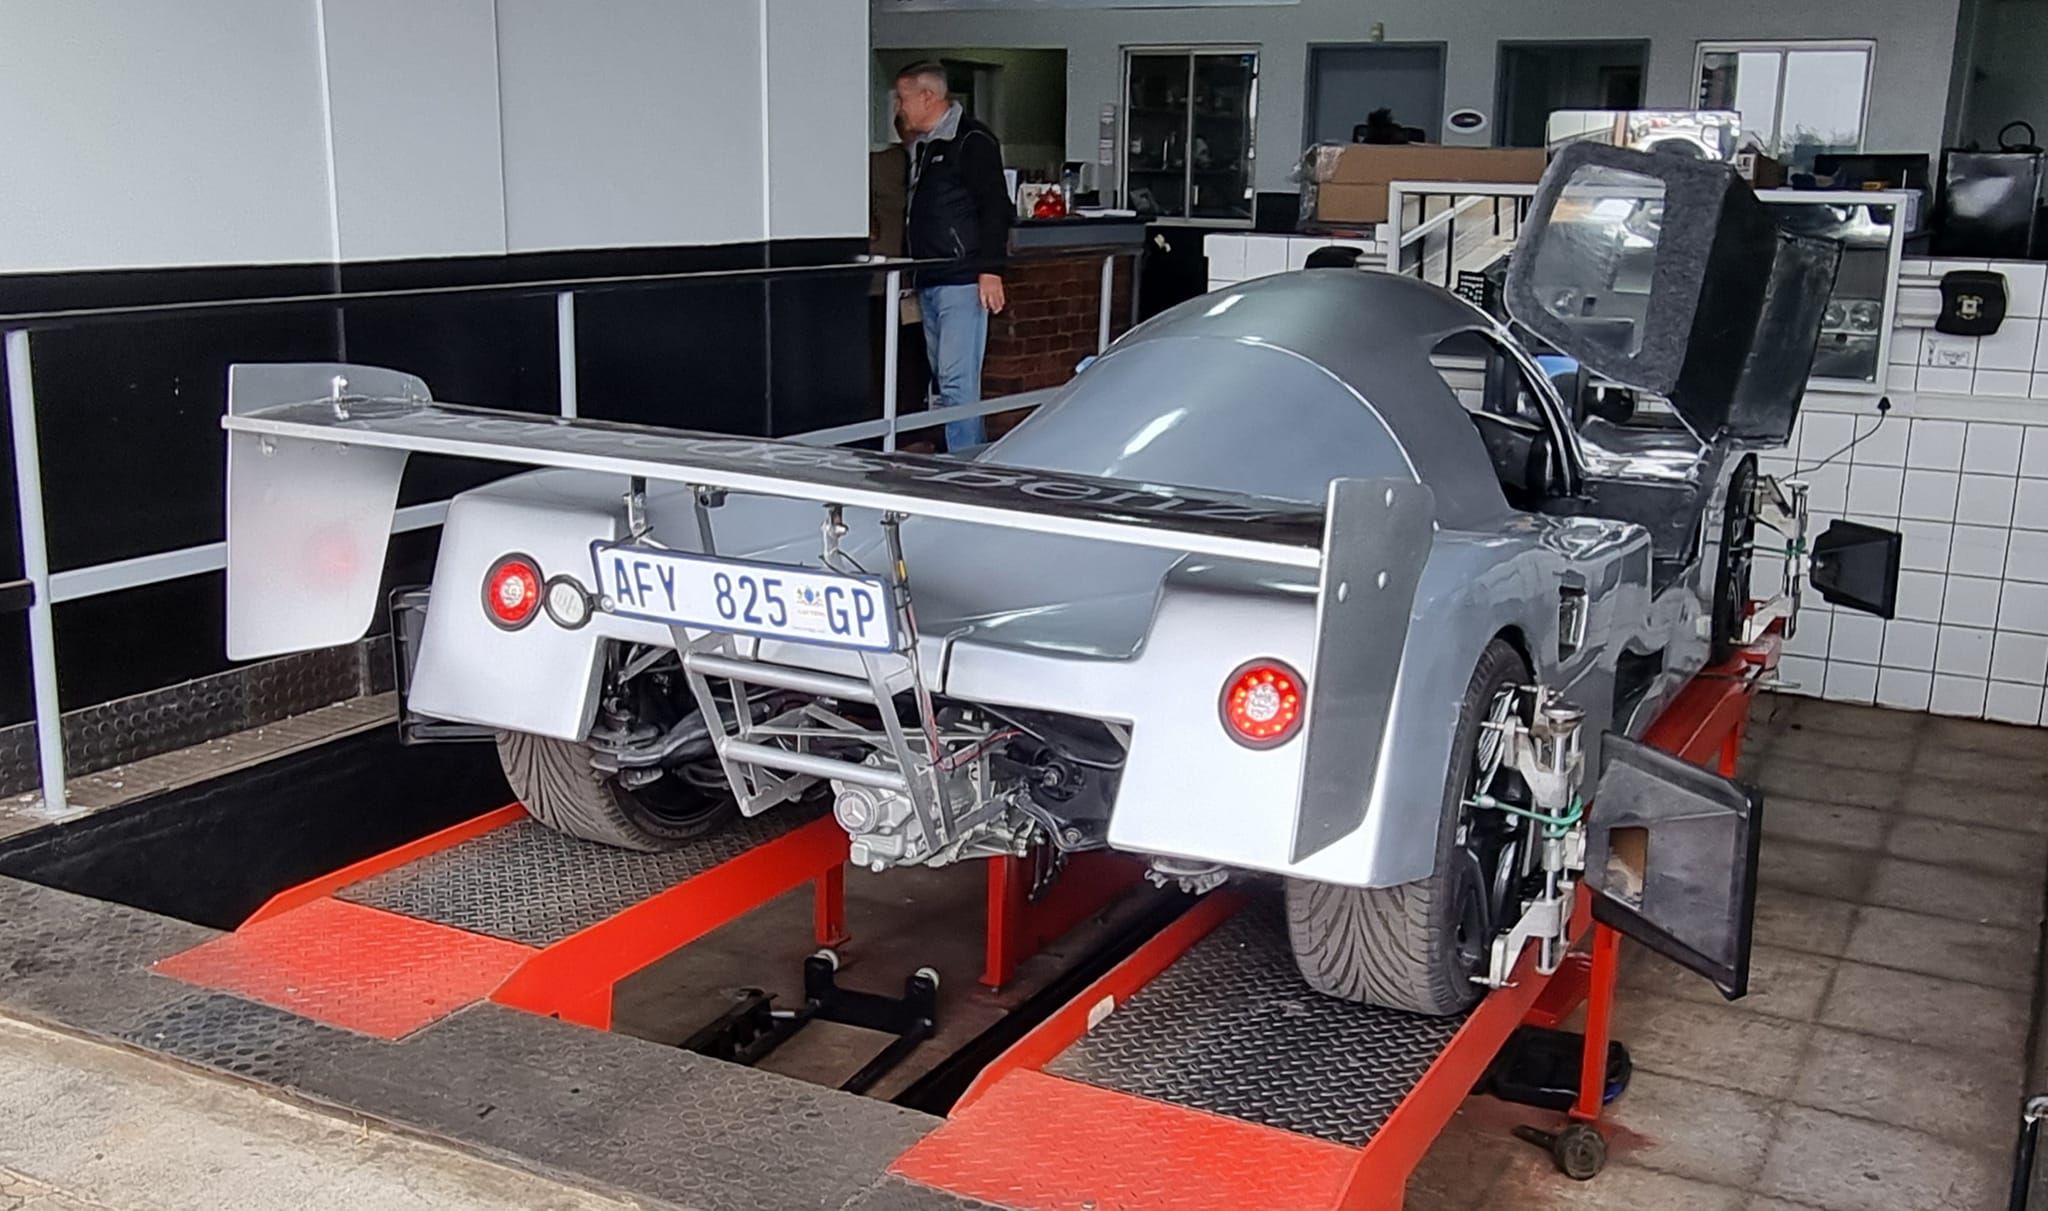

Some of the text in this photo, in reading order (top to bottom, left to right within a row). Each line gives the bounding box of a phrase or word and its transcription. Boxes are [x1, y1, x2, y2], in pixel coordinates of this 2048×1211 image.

[613, 556, 876, 637] AFY 825 GP
